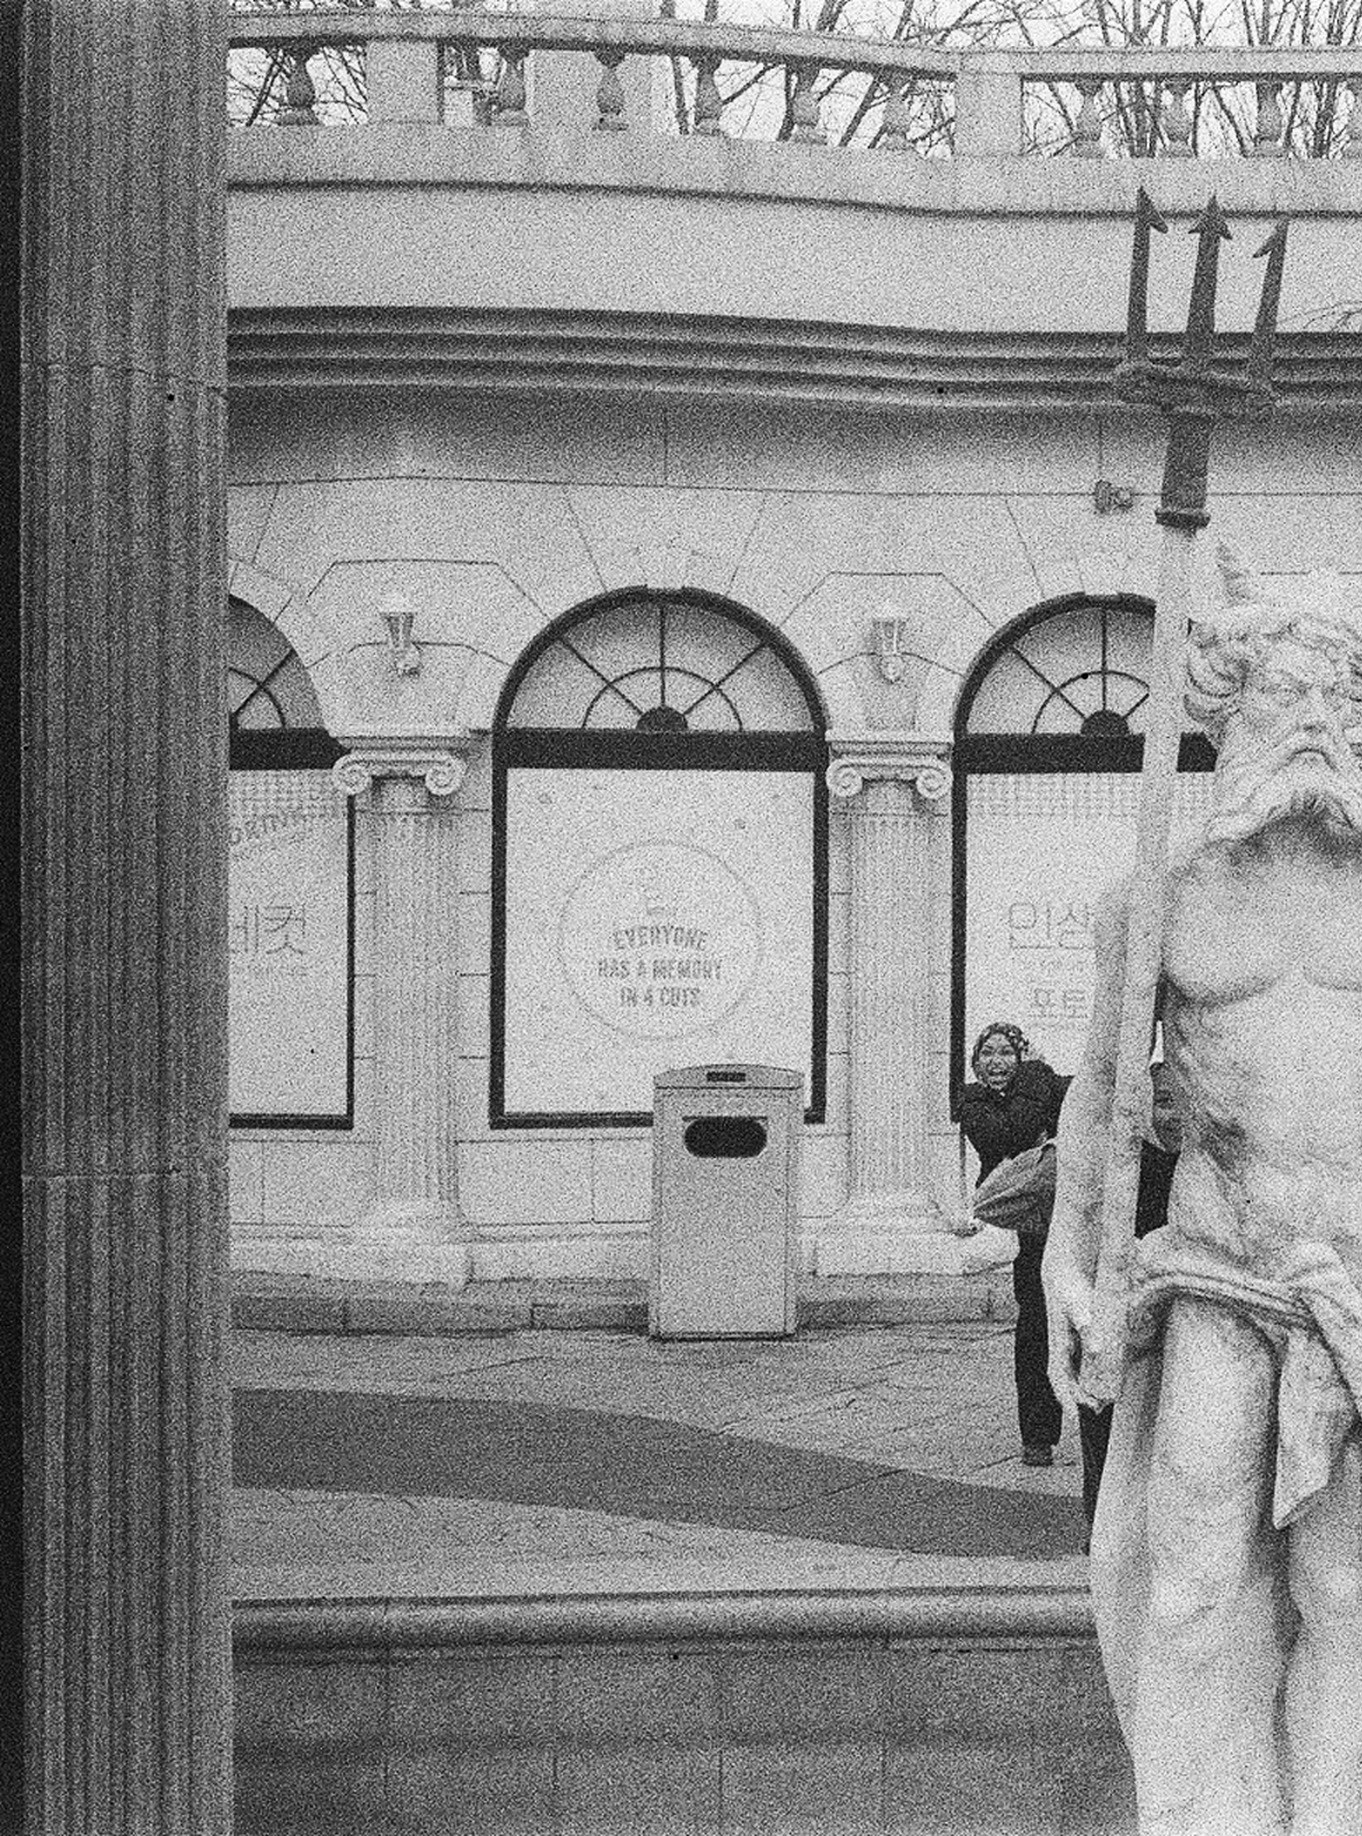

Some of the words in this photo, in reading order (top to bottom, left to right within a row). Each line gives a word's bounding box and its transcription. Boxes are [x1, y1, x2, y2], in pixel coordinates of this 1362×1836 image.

[612, 923, 709, 950] EVERYONE
[597, 958, 631, 980] HAS
[637, 959, 647, 978] A
[652, 958, 722, 980] MEMORY
[619, 986, 639, 1007] IN
[643, 985, 654, 1007] 4
[658, 985, 701, 1008] CUTS
